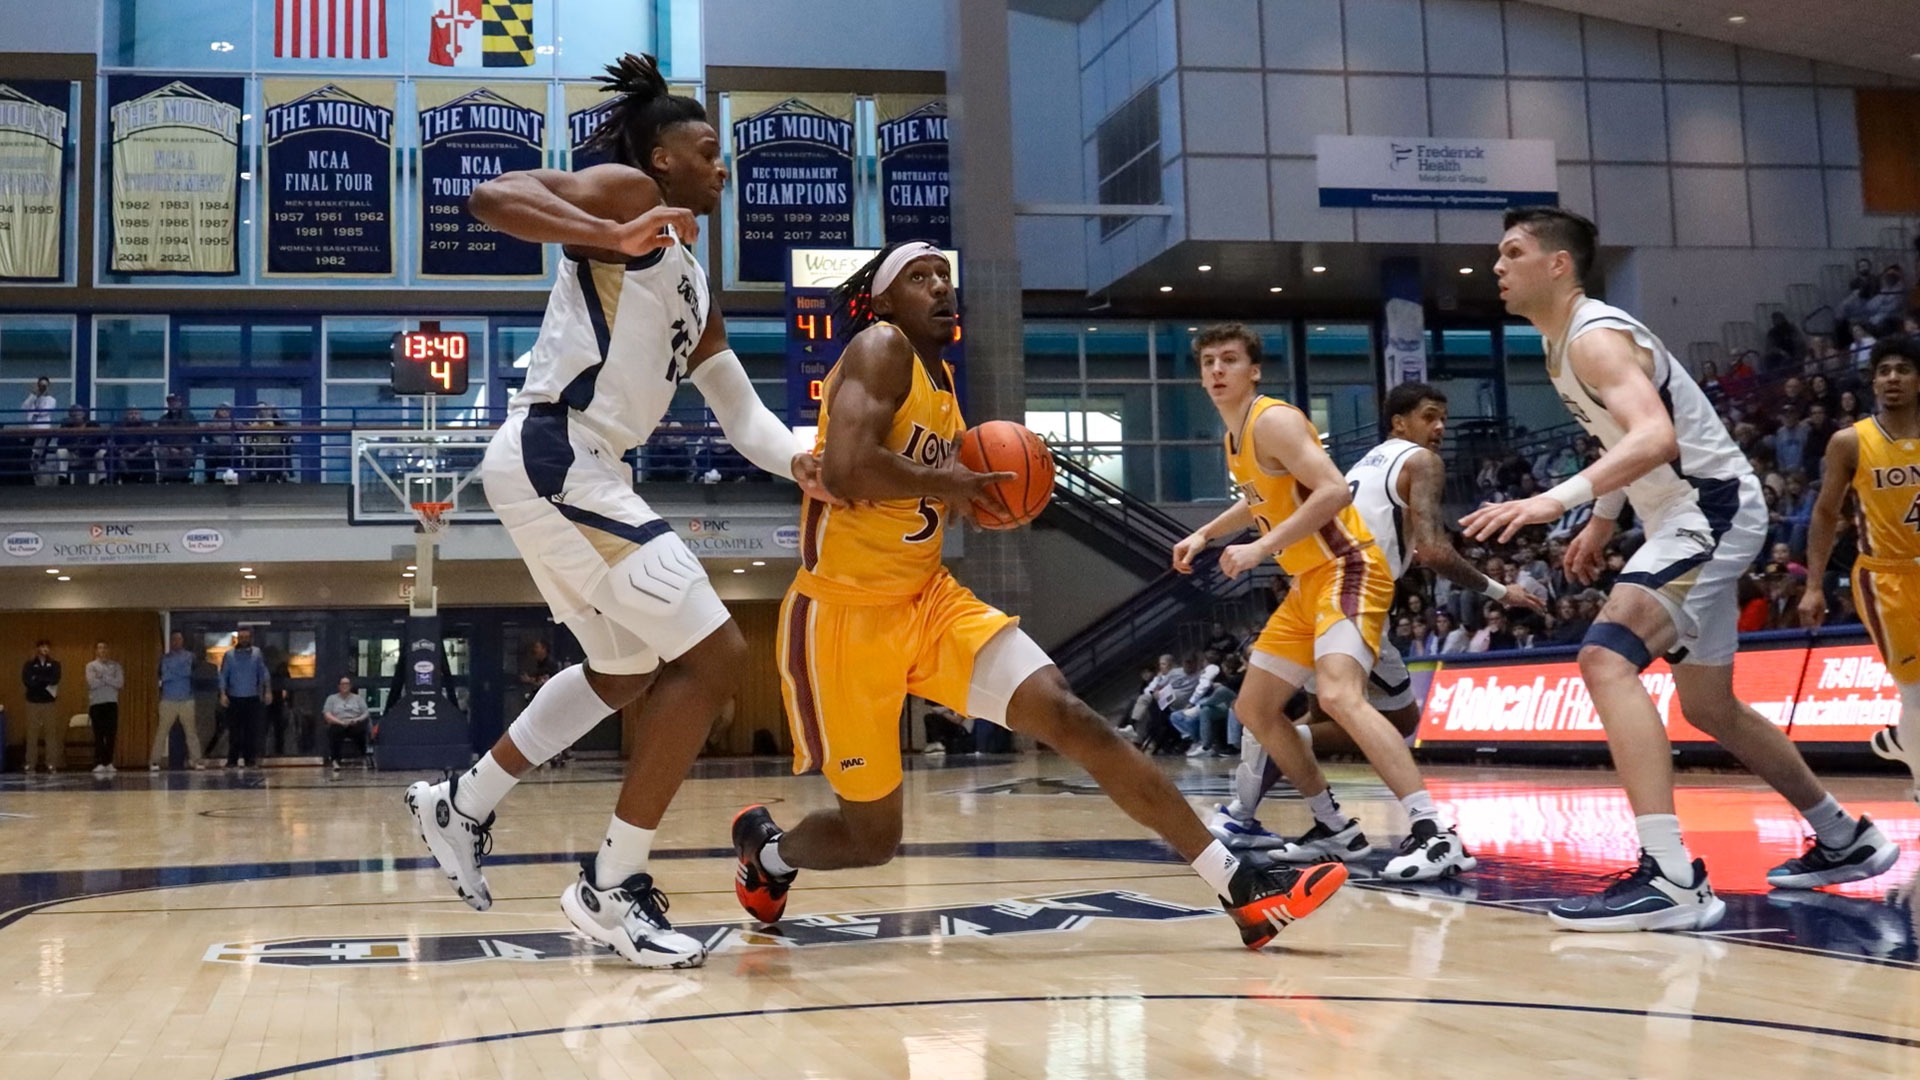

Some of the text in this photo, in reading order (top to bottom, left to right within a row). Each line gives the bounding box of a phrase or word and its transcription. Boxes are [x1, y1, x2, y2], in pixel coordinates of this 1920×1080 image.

[116, 99, 238, 140] THE MOUNT
[268, 102, 391, 140] THE MOUNT
[421, 105, 543, 143] THE MOUNT
[736, 115, 852, 152] THE MOUNT
[880, 119, 920, 152] THE
[1416, 144, 1485, 159] Frederick
[308, 150, 350, 169] NCAA
[461, 156, 503, 175] NCAA
[1418, 158, 1461, 171] Health
[752, 167, 838, 179] NEC TOURNAMENT
[892, 171, 937, 181] NORTHEAST
[1458, 174, 1488, 184] Group
[285, 173, 373, 191] FINAL FOUR
[745, 183, 847, 205] CHAMPIONS
[890, 184, 949, 207] CHAMP
[0, 204, 53, 214] 94 1995
[120, 201, 230, 210] 1982 1983 1984
[430, 205, 459, 214] 1986
[275, 212, 384, 221] 1957 1961 1962
[746, 213, 850, 222] 1995 1999 2008
[120, 219, 230, 228] 1985 1986 1987
[430, 223, 459, 232] 1999
[296, 227, 363, 236] 1981 1985
[745, 231, 847, 240] 2014 2017 2021
[120, 236, 230, 246] 1988 1994 1995
[430, 241, 496, 251] 2017 2021
[120, 253, 190, 262] 2021 2022
[315, 256, 346, 265] 1982
[797, 296, 826, 309] Home
[797, 314, 832, 339] 41
[404, 335, 465, 359] 13:40
[430, 361, 450, 389] 4
[106, 524, 134, 536] PNC
[703, 520, 731, 531] PNC
[53, 542, 171, 557] SPORTS COMPLEX
[703, 536, 764, 550] COMPLEX
[1445, 675, 1545, 731] Bobcat
[1535, 677, 1568, 731] of
[840, 757, 865, 771] MAAC
